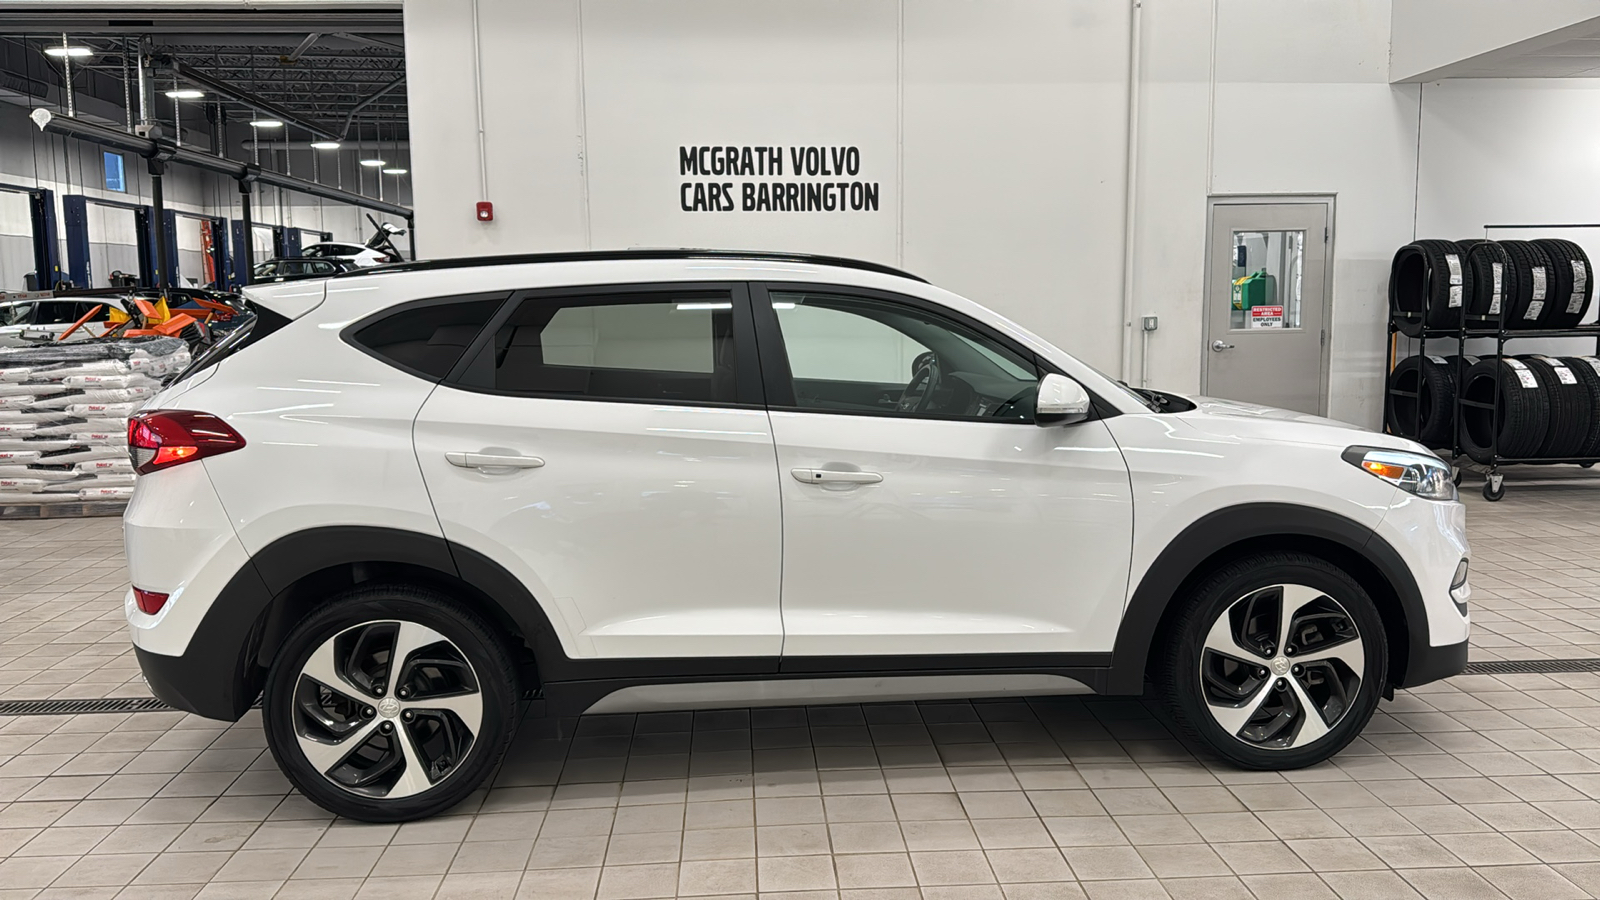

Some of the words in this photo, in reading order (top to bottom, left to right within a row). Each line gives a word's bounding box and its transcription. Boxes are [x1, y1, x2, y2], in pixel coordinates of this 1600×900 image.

[679, 146, 783, 175] MCGRATH
[790, 146, 860, 176] VOLVO
[680, 182, 734, 212] CARS
[742, 181, 879, 212] BARRINGTON
